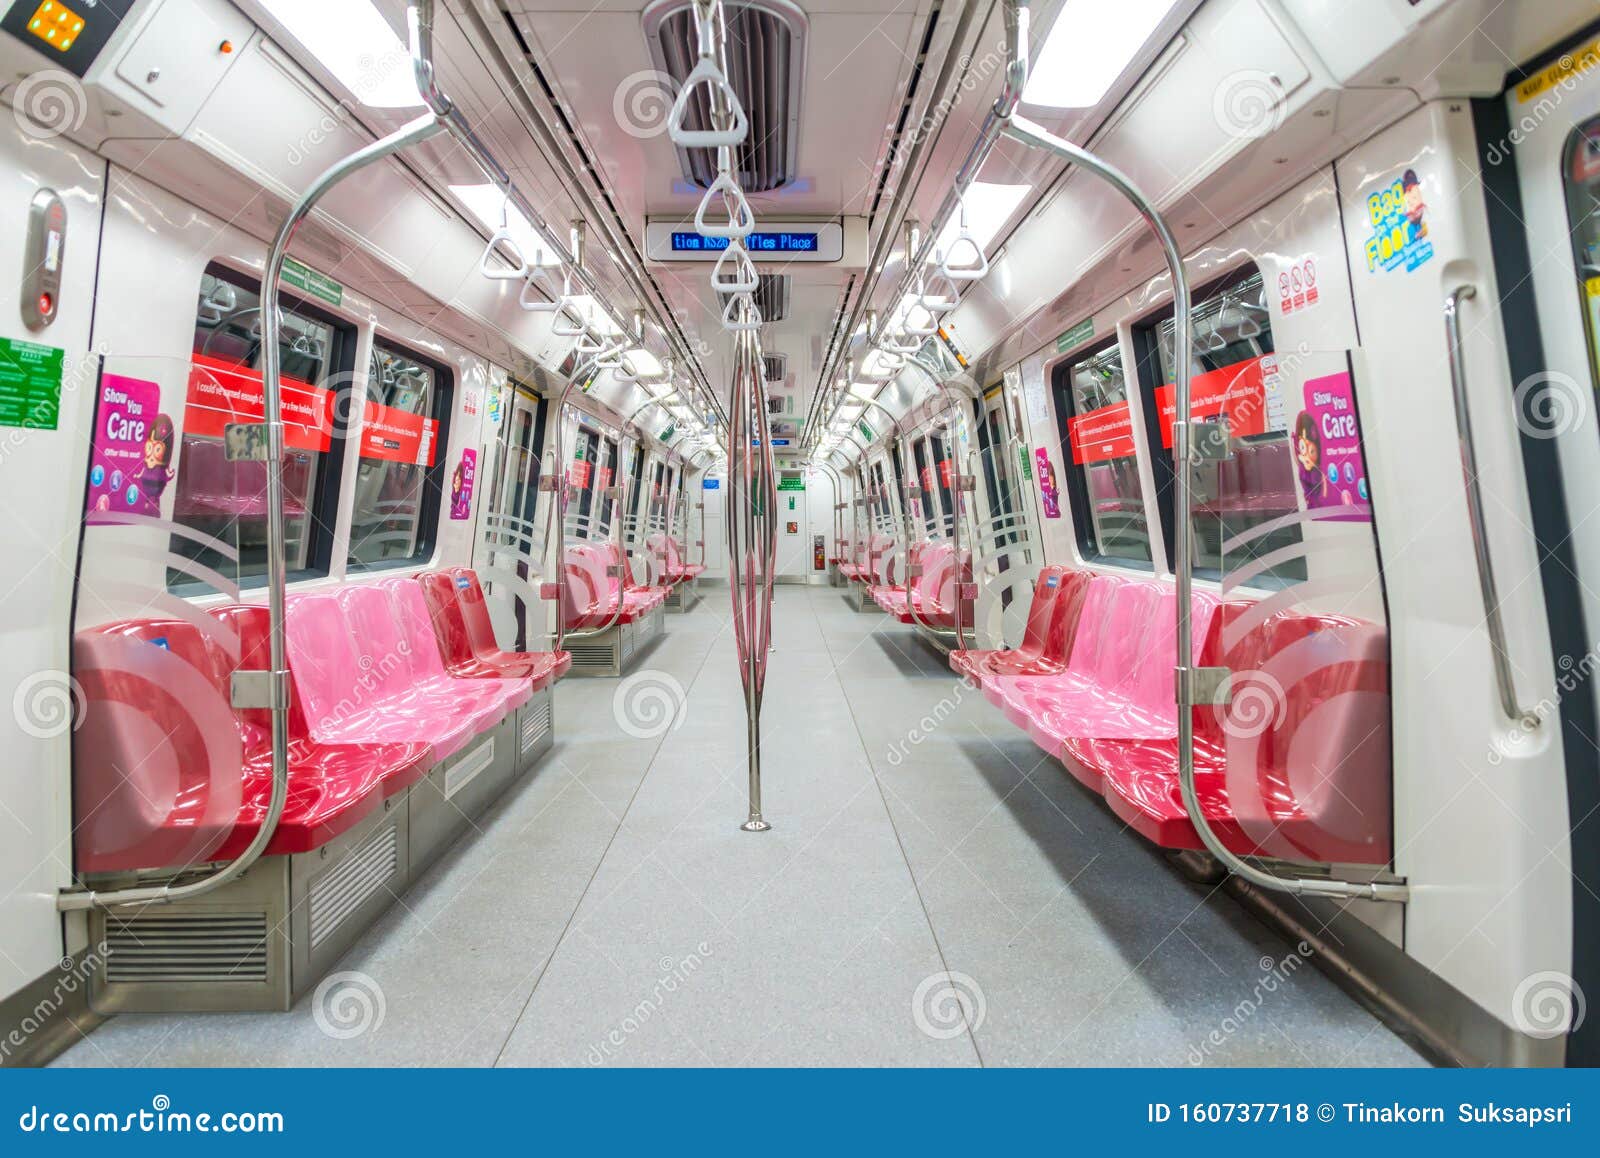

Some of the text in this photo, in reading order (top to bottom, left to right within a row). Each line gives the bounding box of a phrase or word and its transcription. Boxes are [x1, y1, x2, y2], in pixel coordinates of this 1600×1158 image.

[1367, 181, 1405, 226] Bag
[674, 234, 700, 249] tion
[780, 234, 811, 249] Place
[1364, 219, 1410, 272] Floor
[103, 387, 128, 404] Show
[1313, 391, 1331, 406] Show
[1332, 396, 1347, 410] You
[127, 400, 143, 415] You
[107, 412, 145, 442] Care
[1322, 412, 1356, 439] Care
